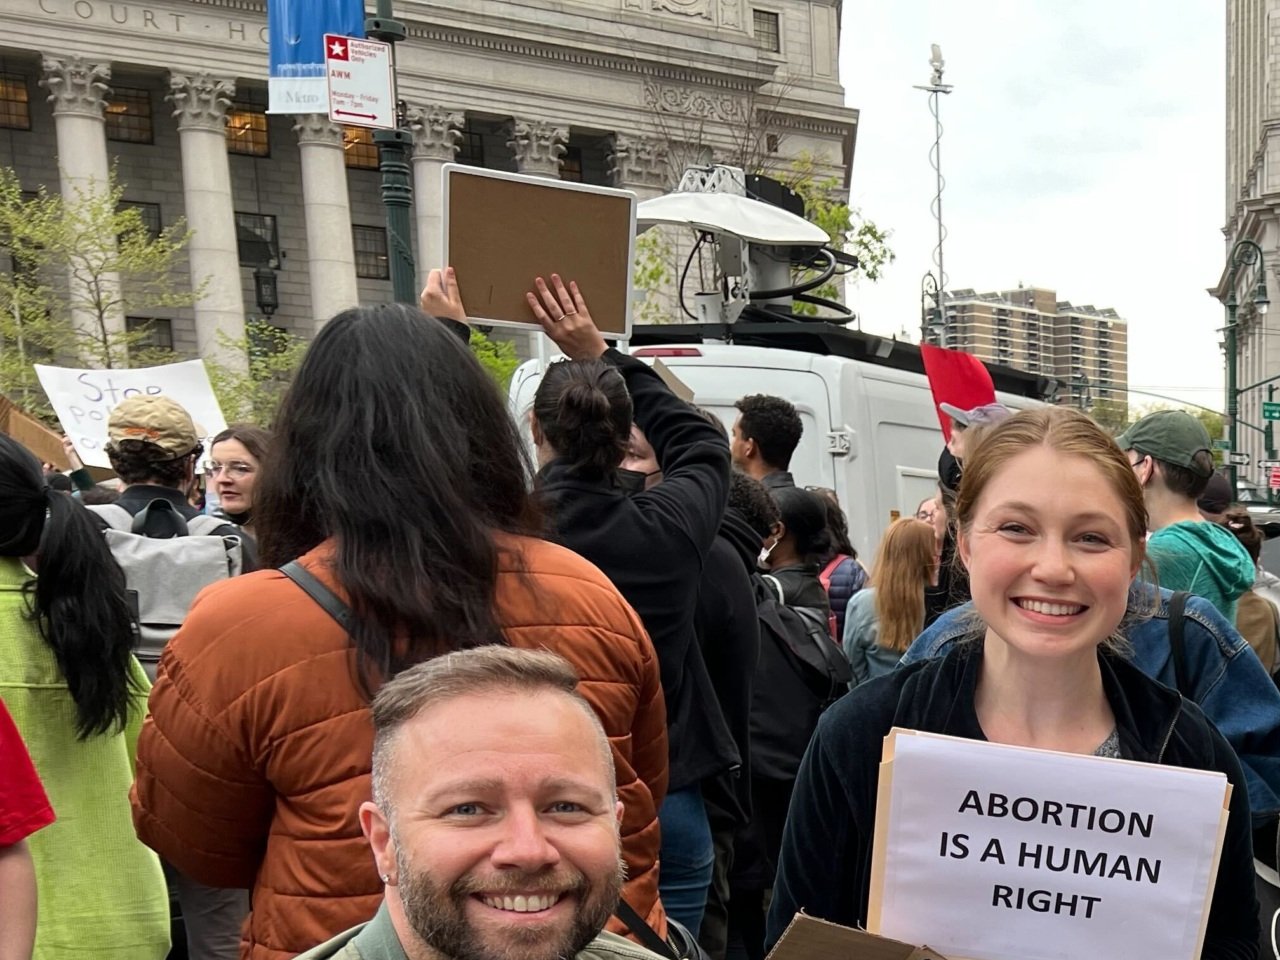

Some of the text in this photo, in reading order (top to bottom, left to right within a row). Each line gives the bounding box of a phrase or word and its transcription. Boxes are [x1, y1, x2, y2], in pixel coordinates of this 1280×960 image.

[39, 0, 185, 32] COURT
[350, 42, 385, 53] Authorized
[350, 49, 377, 58] Vehicles
[958, 789, 1154, 838] ABORTION
[939, 831, 1161, 884] IS A HUMAN
[992, 884, 1102, 919] RIGHT
